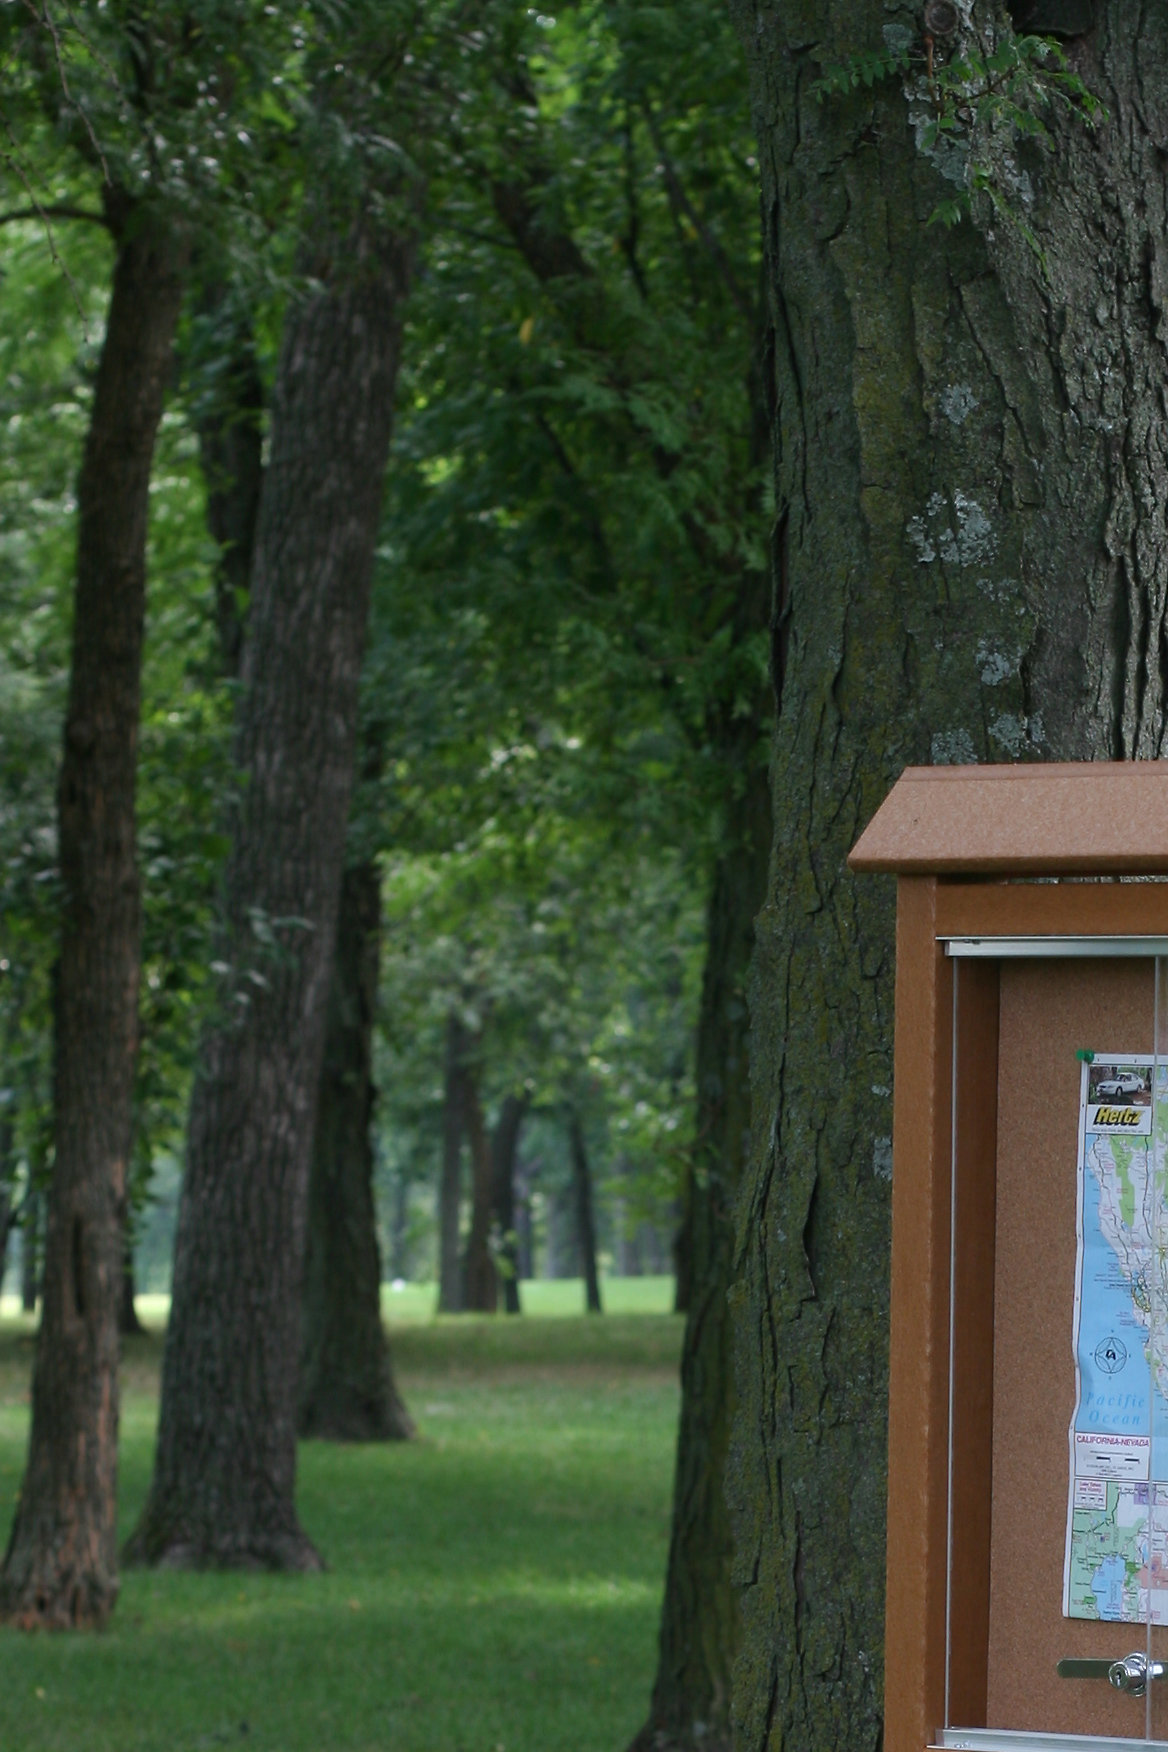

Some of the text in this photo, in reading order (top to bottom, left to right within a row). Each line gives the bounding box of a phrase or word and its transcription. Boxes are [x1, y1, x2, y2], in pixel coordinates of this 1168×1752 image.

[1093, 1106, 1142, 1126] Hertz
[1086, 1392, 1145, 1409] Pacific
[1089, 1410, 1141, 1425] Ocean
